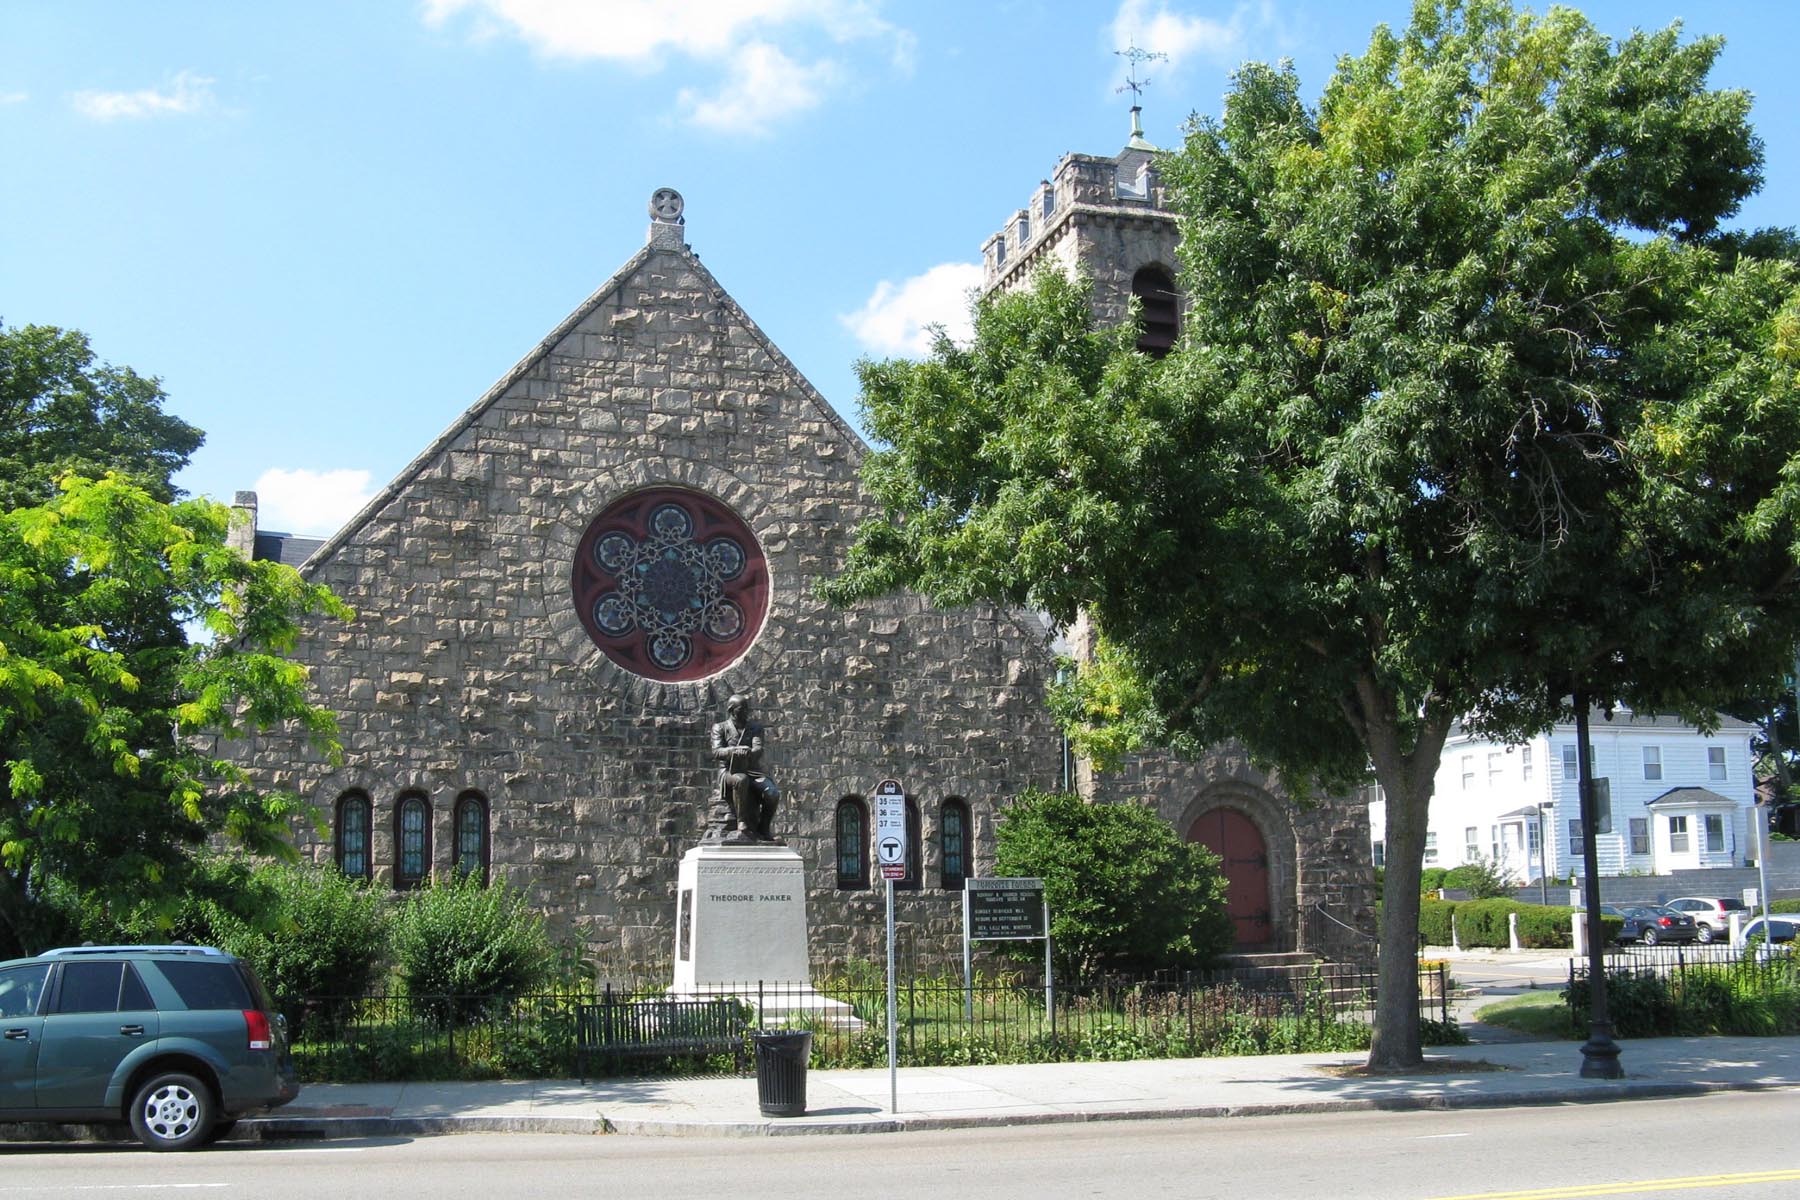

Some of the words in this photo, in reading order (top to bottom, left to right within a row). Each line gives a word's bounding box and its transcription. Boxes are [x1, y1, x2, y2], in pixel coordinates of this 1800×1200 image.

[879, 820, 888, 828] 37
[882, 843, 899, 858] T
[710, 894, 754, 902] THEODORE
[759, 894, 792, 902] PARKER
